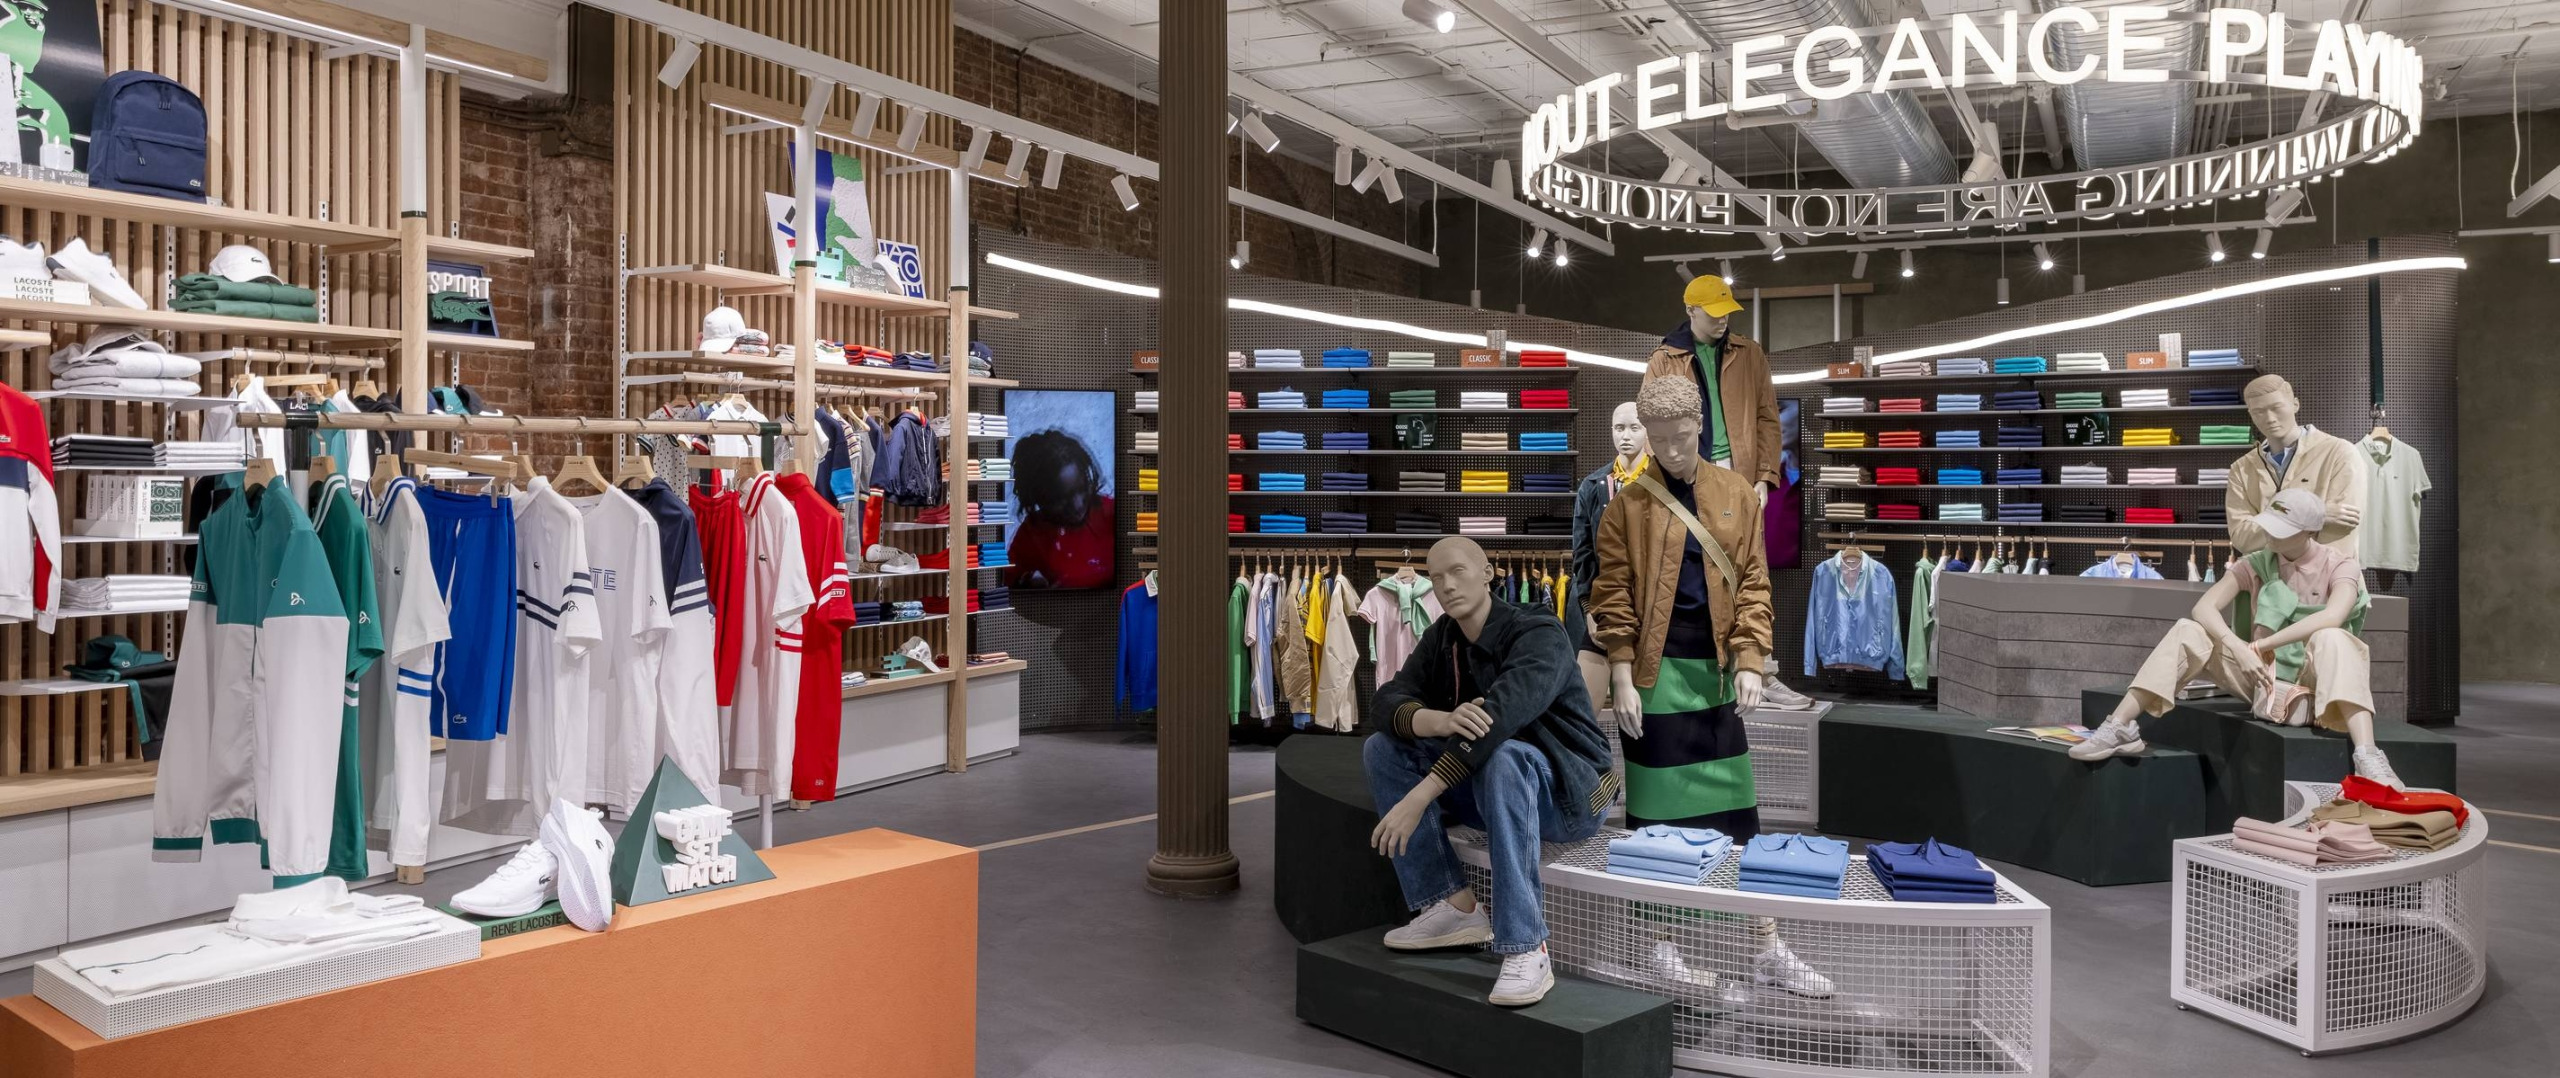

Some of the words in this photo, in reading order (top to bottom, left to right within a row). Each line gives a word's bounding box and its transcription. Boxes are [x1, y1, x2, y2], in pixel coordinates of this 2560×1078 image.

[1637, 6, 2169, 131] ELEGANCE
[14, 277, 53, 287] LACOSTE
[427, 271, 493, 300] SPORT
[16, 285, 55, 295] LACOSTE
[16, 294, 55, 302] LACOSTE
[1140, 356, 1159, 364] CLASSI
[1469, 354, 1492, 363] CLASSIC
[2138, 357, 2154, 365] SLIM
[1837, 367, 1850, 375] SLIM
[670, 808, 733, 844] GAME
[681, 840, 719, 865] SET
[662, 853, 737, 893] MATCH
[491, 921, 517, 937] RENE
[520, 912, 562, 932] LACOSTE
